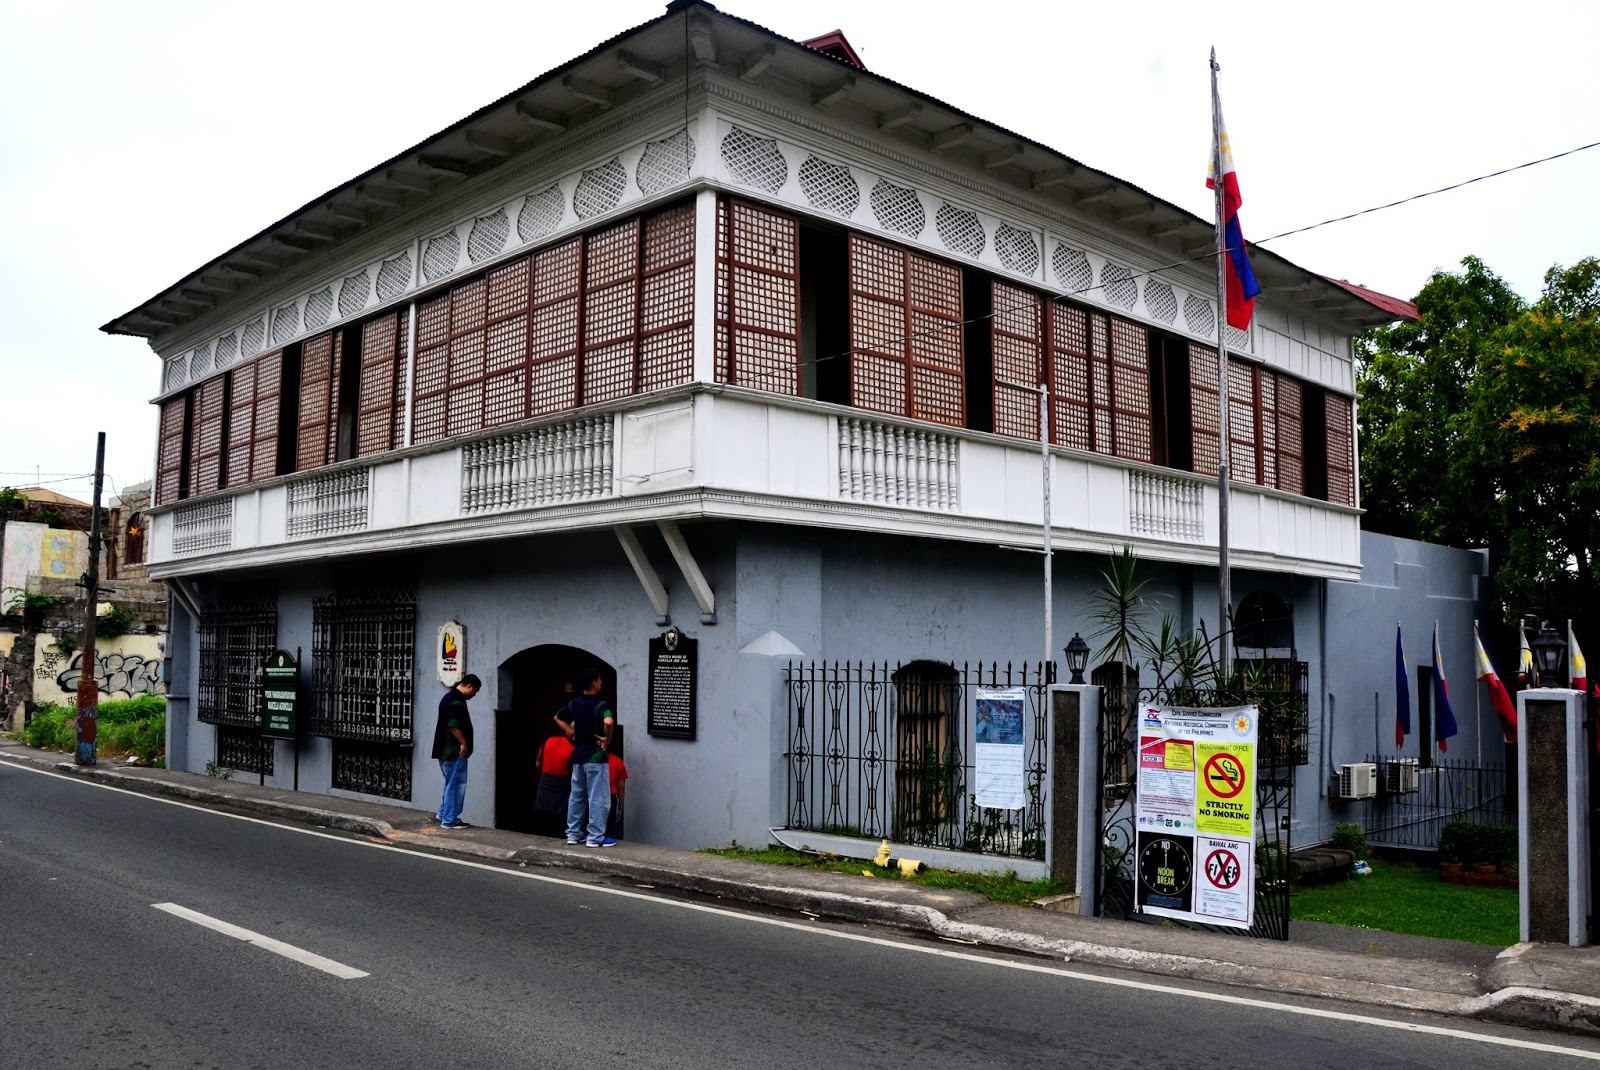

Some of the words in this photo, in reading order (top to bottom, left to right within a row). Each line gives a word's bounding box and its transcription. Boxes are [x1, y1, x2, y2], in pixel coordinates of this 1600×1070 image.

[1206, 801, 1243, 810] STRICTLY
[1213, 810, 1250, 820] SMOKING
[1161, 841, 1170, 850] NO
[1158, 867, 1174, 877] NOON
[1157, 876, 1175, 886] BREAK
